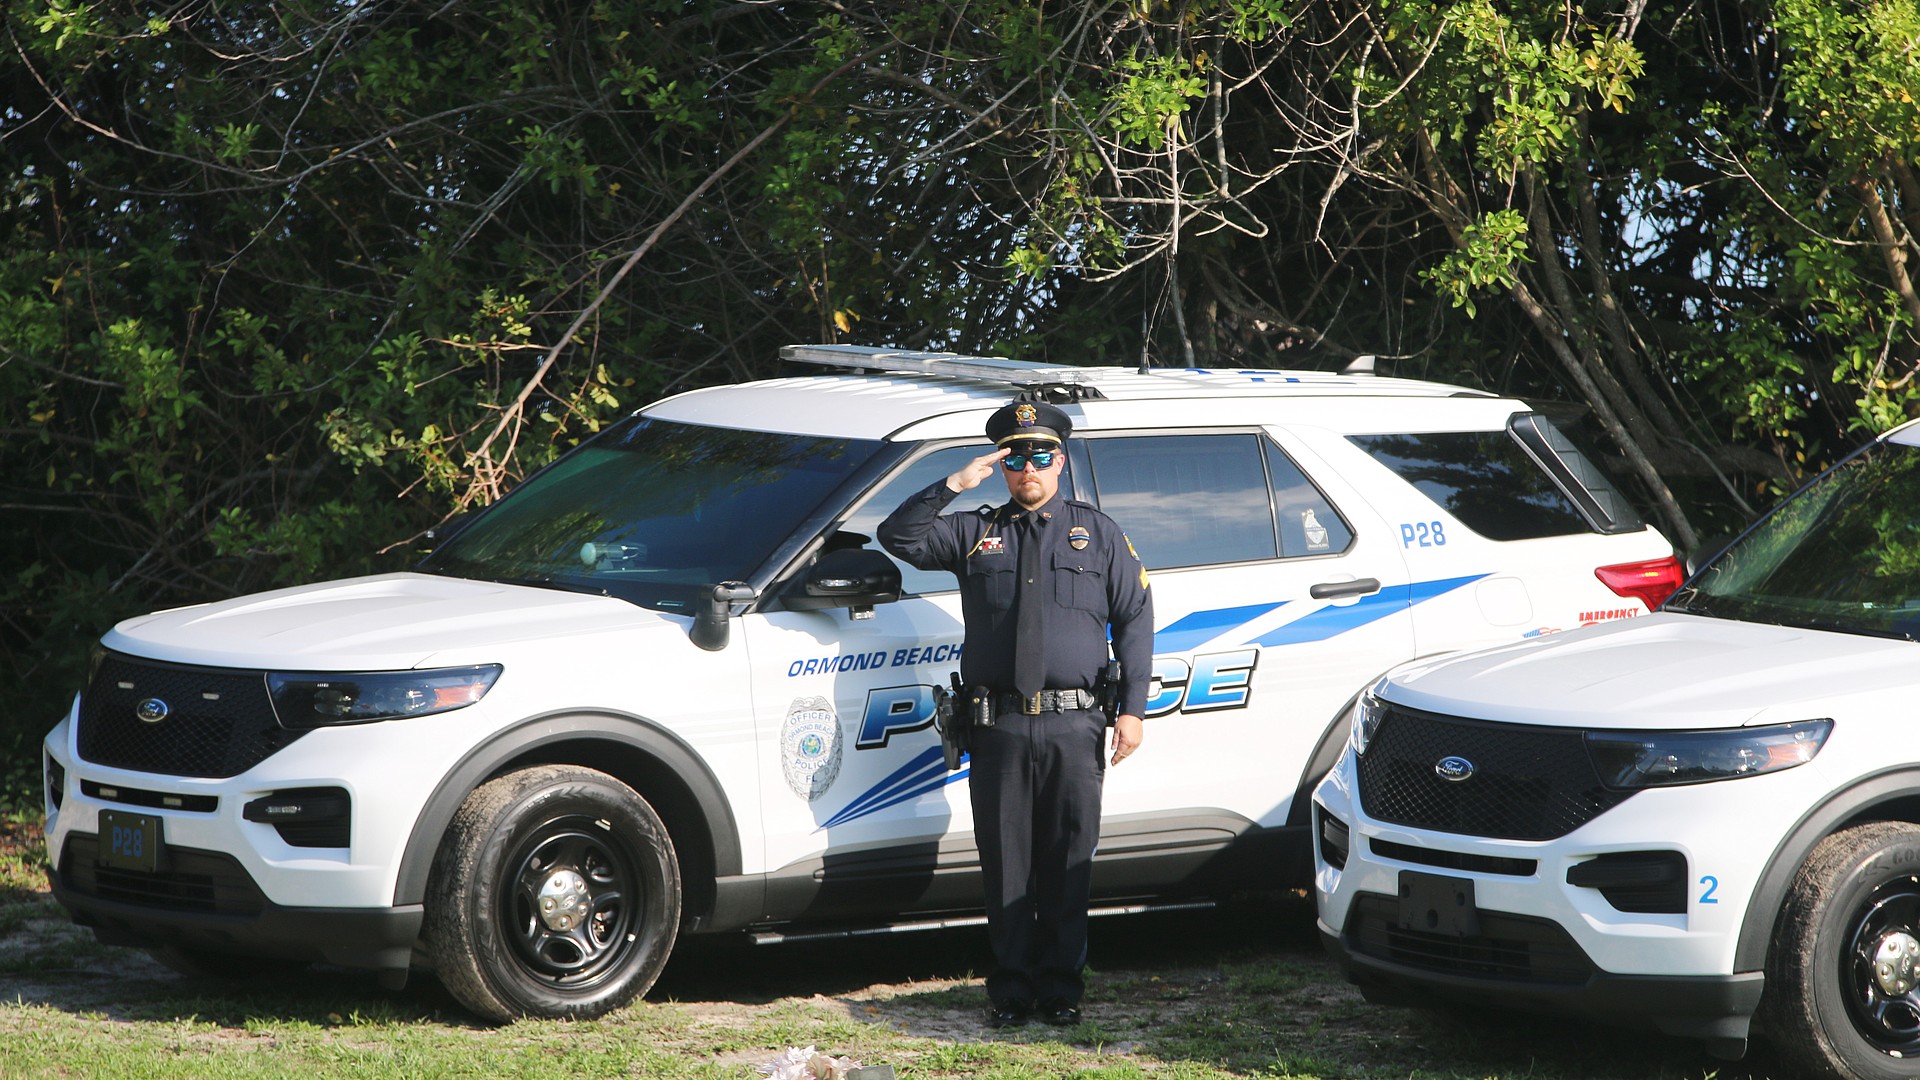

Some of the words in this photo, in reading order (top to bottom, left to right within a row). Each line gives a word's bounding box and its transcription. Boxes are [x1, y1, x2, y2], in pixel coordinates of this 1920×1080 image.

[1400, 521, 1446, 549] P28
[787, 651, 887, 677] ORMOND
[891, 643, 964, 668] BEACH
[788, 724, 813, 742] ORMOND
[814, 723, 835, 737] BEACH
[790, 712, 832, 725] OFFICER
[805, 774, 818, 783] FL
[112, 826, 143, 857] P28
[1699, 875, 1719, 904] 2
